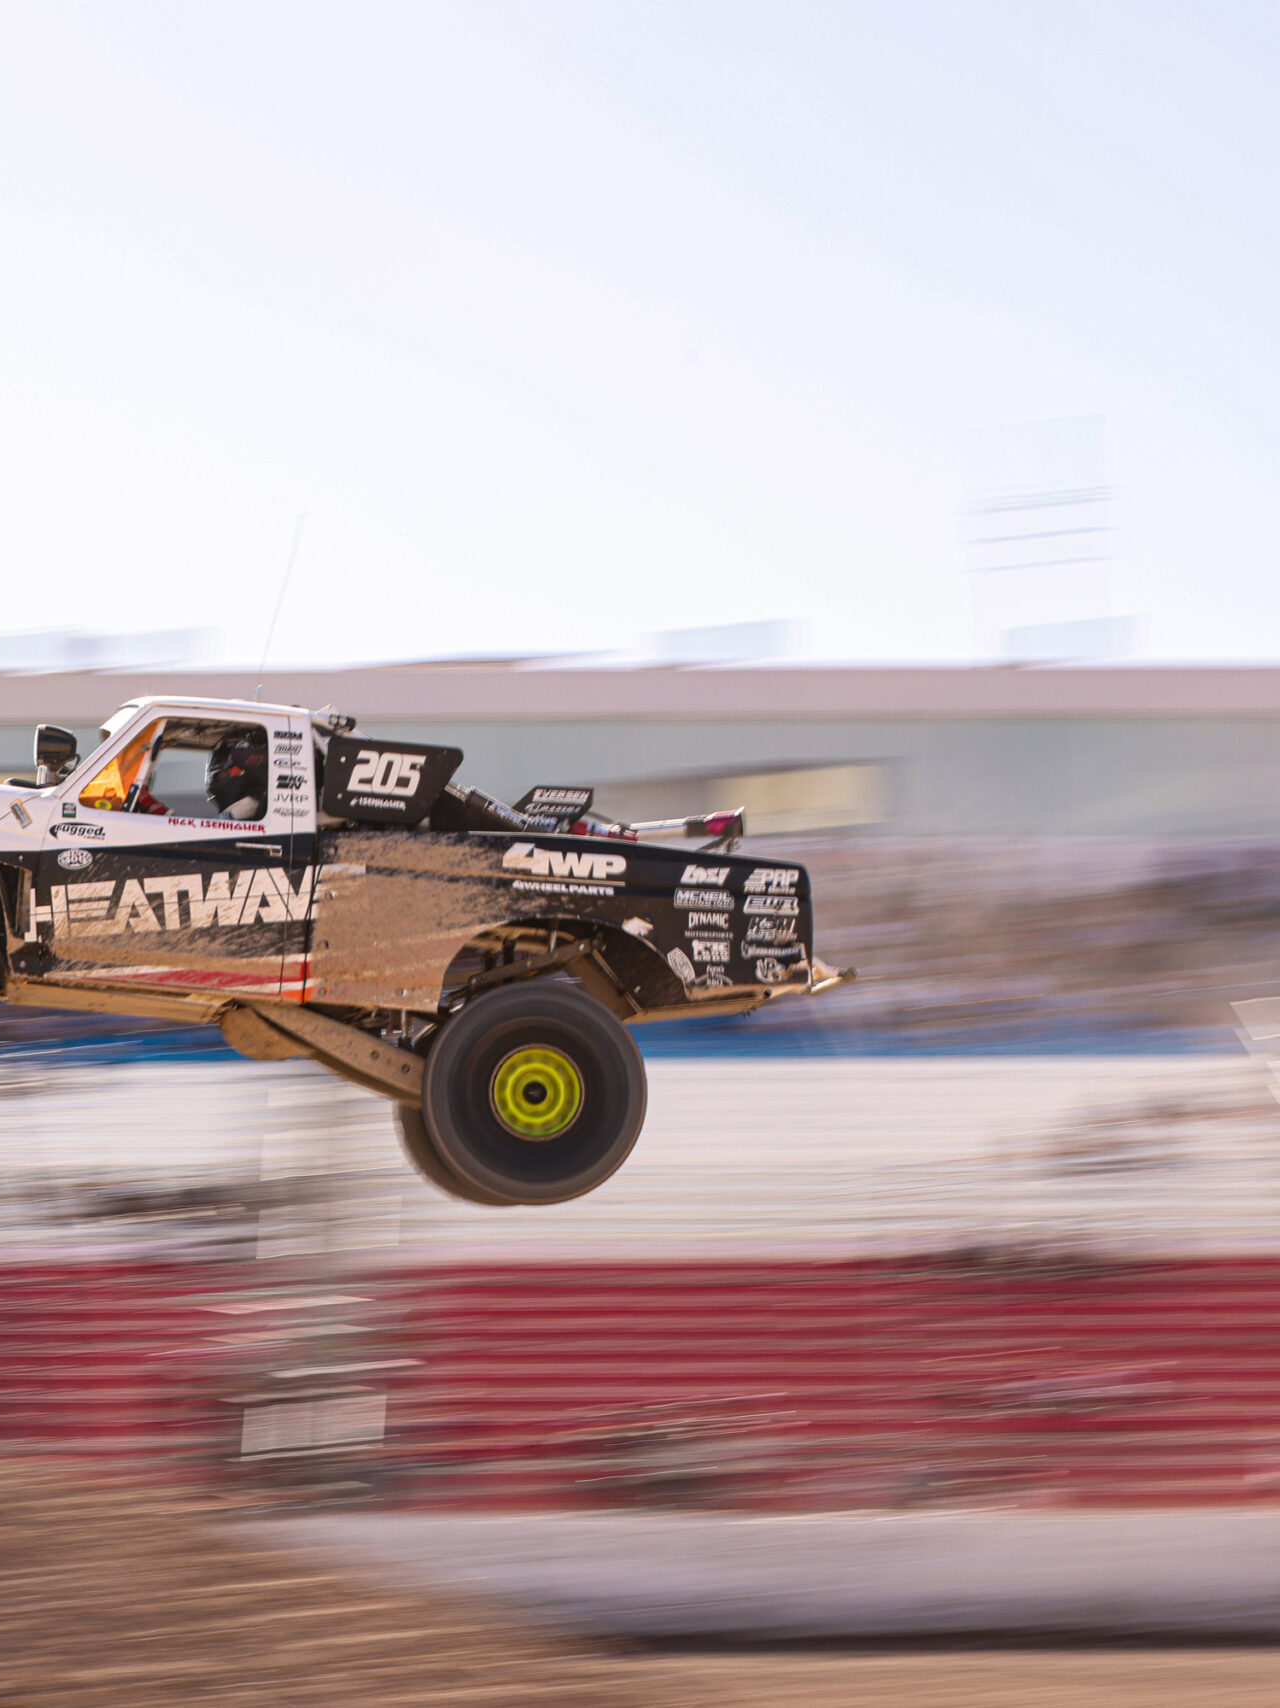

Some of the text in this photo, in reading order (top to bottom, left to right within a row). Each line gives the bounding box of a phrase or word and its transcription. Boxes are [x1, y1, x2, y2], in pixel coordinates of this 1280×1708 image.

[347, 749, 427, 796] 205
[502, 842, 627, 879] 4WP
[689, 911, 729, 930] DYNAMIC
